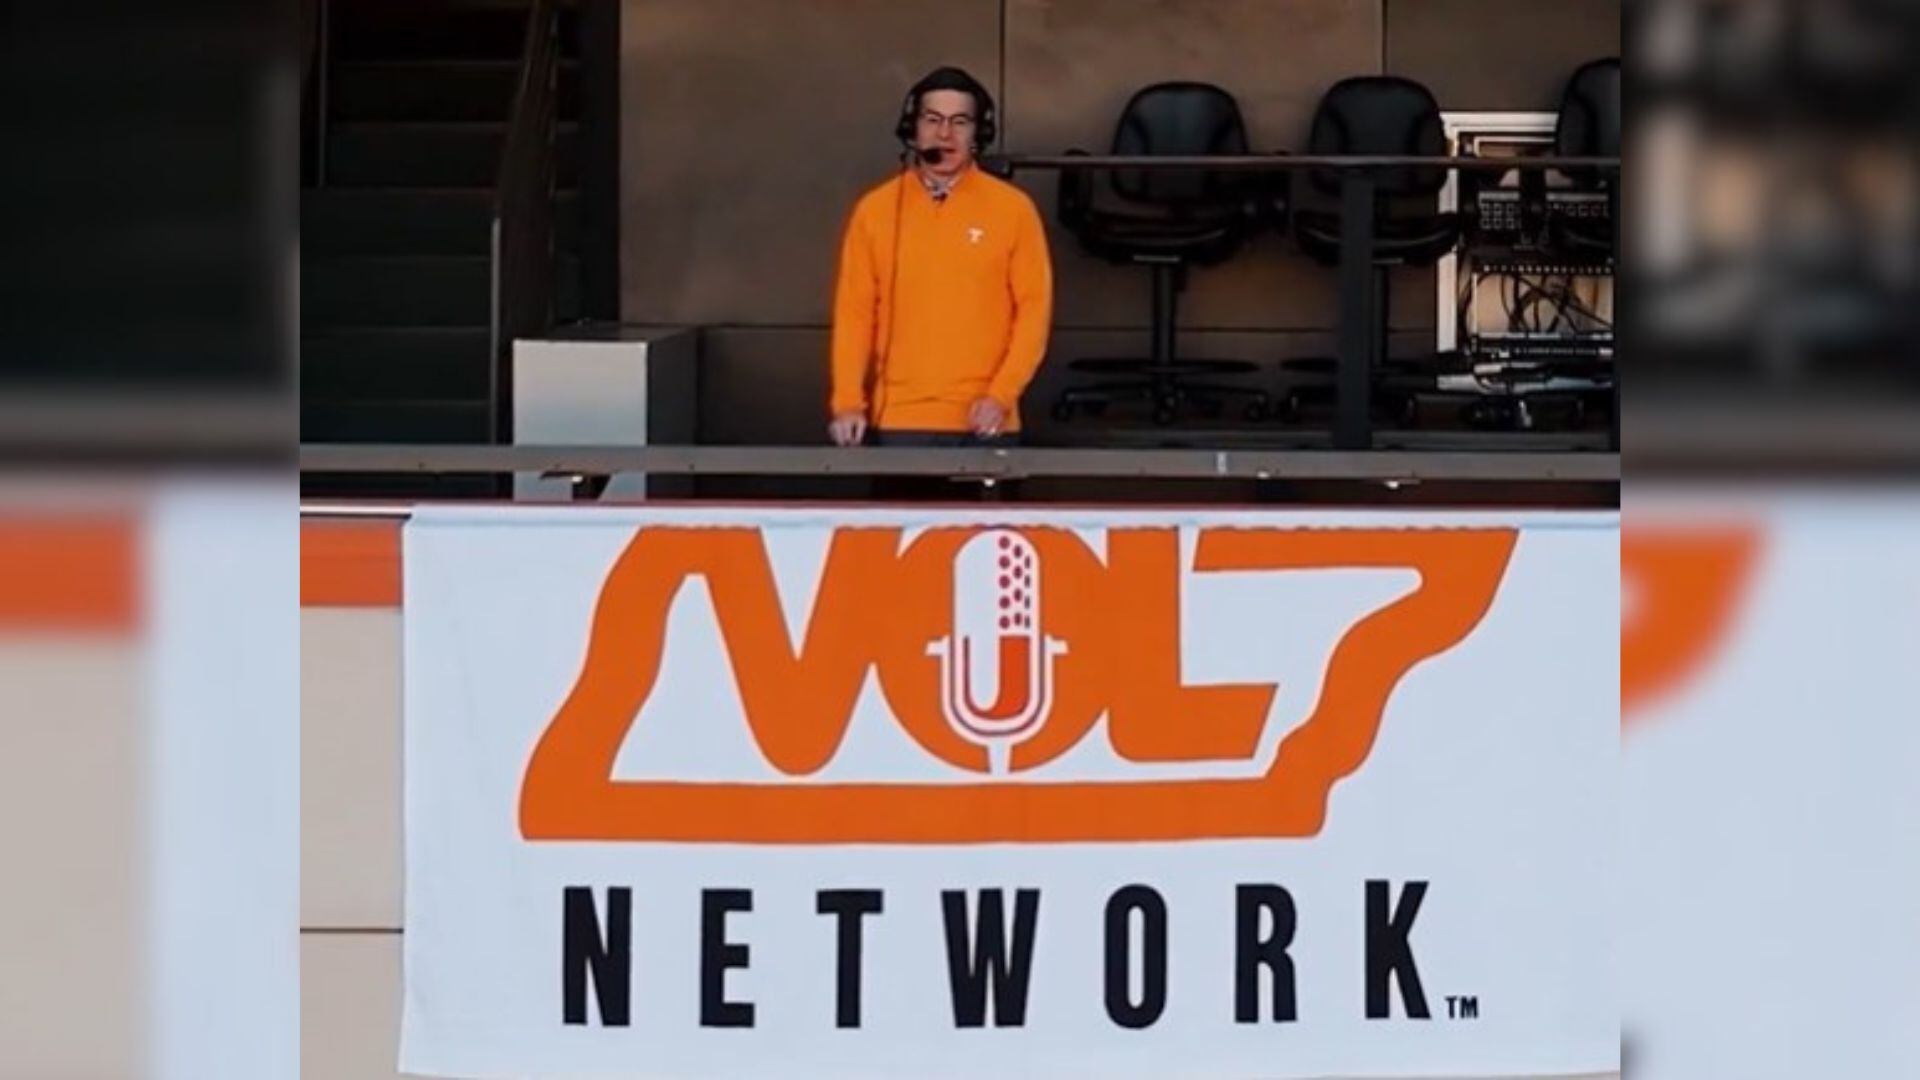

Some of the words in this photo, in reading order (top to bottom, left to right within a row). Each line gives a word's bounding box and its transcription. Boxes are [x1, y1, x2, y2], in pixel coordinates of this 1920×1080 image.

[967, 226, 985, 245] T
[563, 880, 1430, 1029] NETWORK
[1446, 997, 1477, 1018] TM
